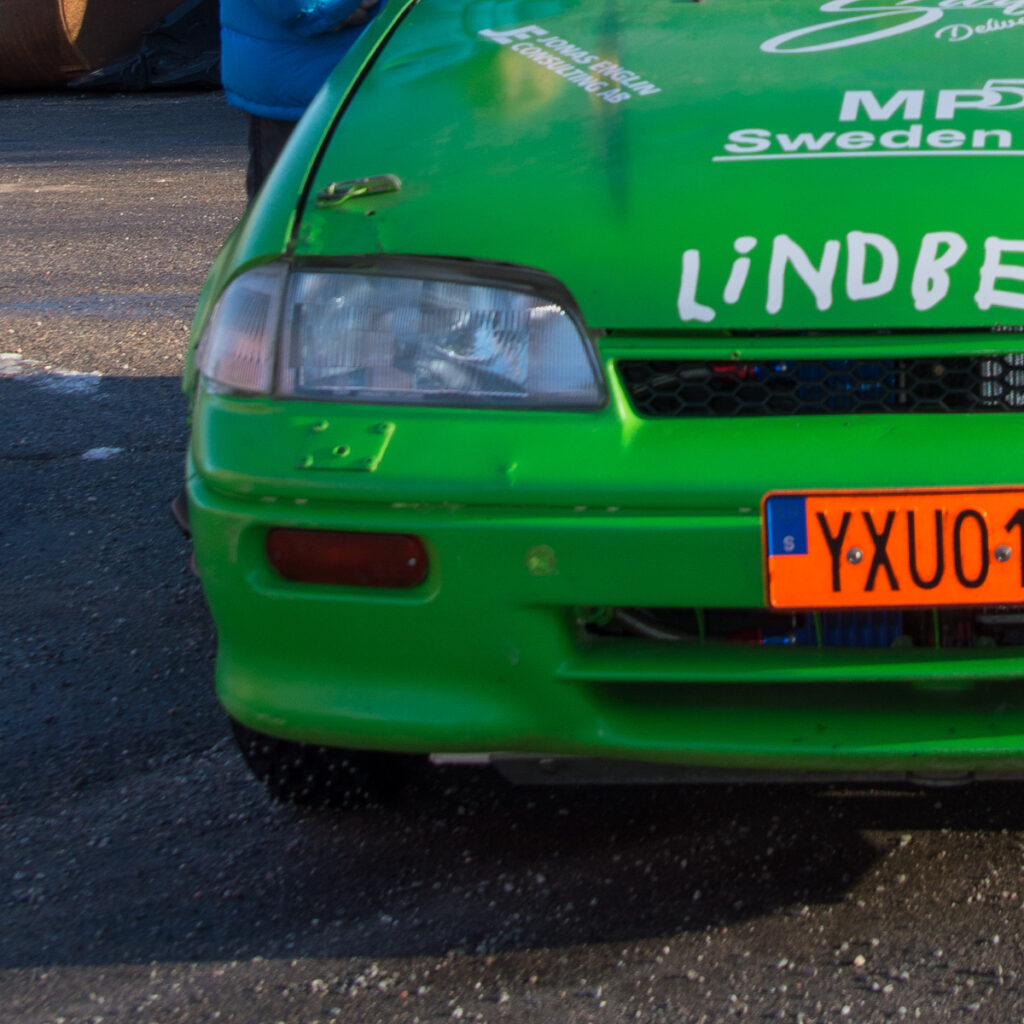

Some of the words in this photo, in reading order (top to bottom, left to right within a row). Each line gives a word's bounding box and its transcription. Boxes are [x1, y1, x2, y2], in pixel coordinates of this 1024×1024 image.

[511, 42, 609, 93] CONSULTING
[596, 88, 631, 104] AB
[536, 36, 599, 64] JONAS
[589, 60, 662, 96] ENGLIN
[724, 124, 1013, 154] Sweden
[782, 536, 796, 552] S
